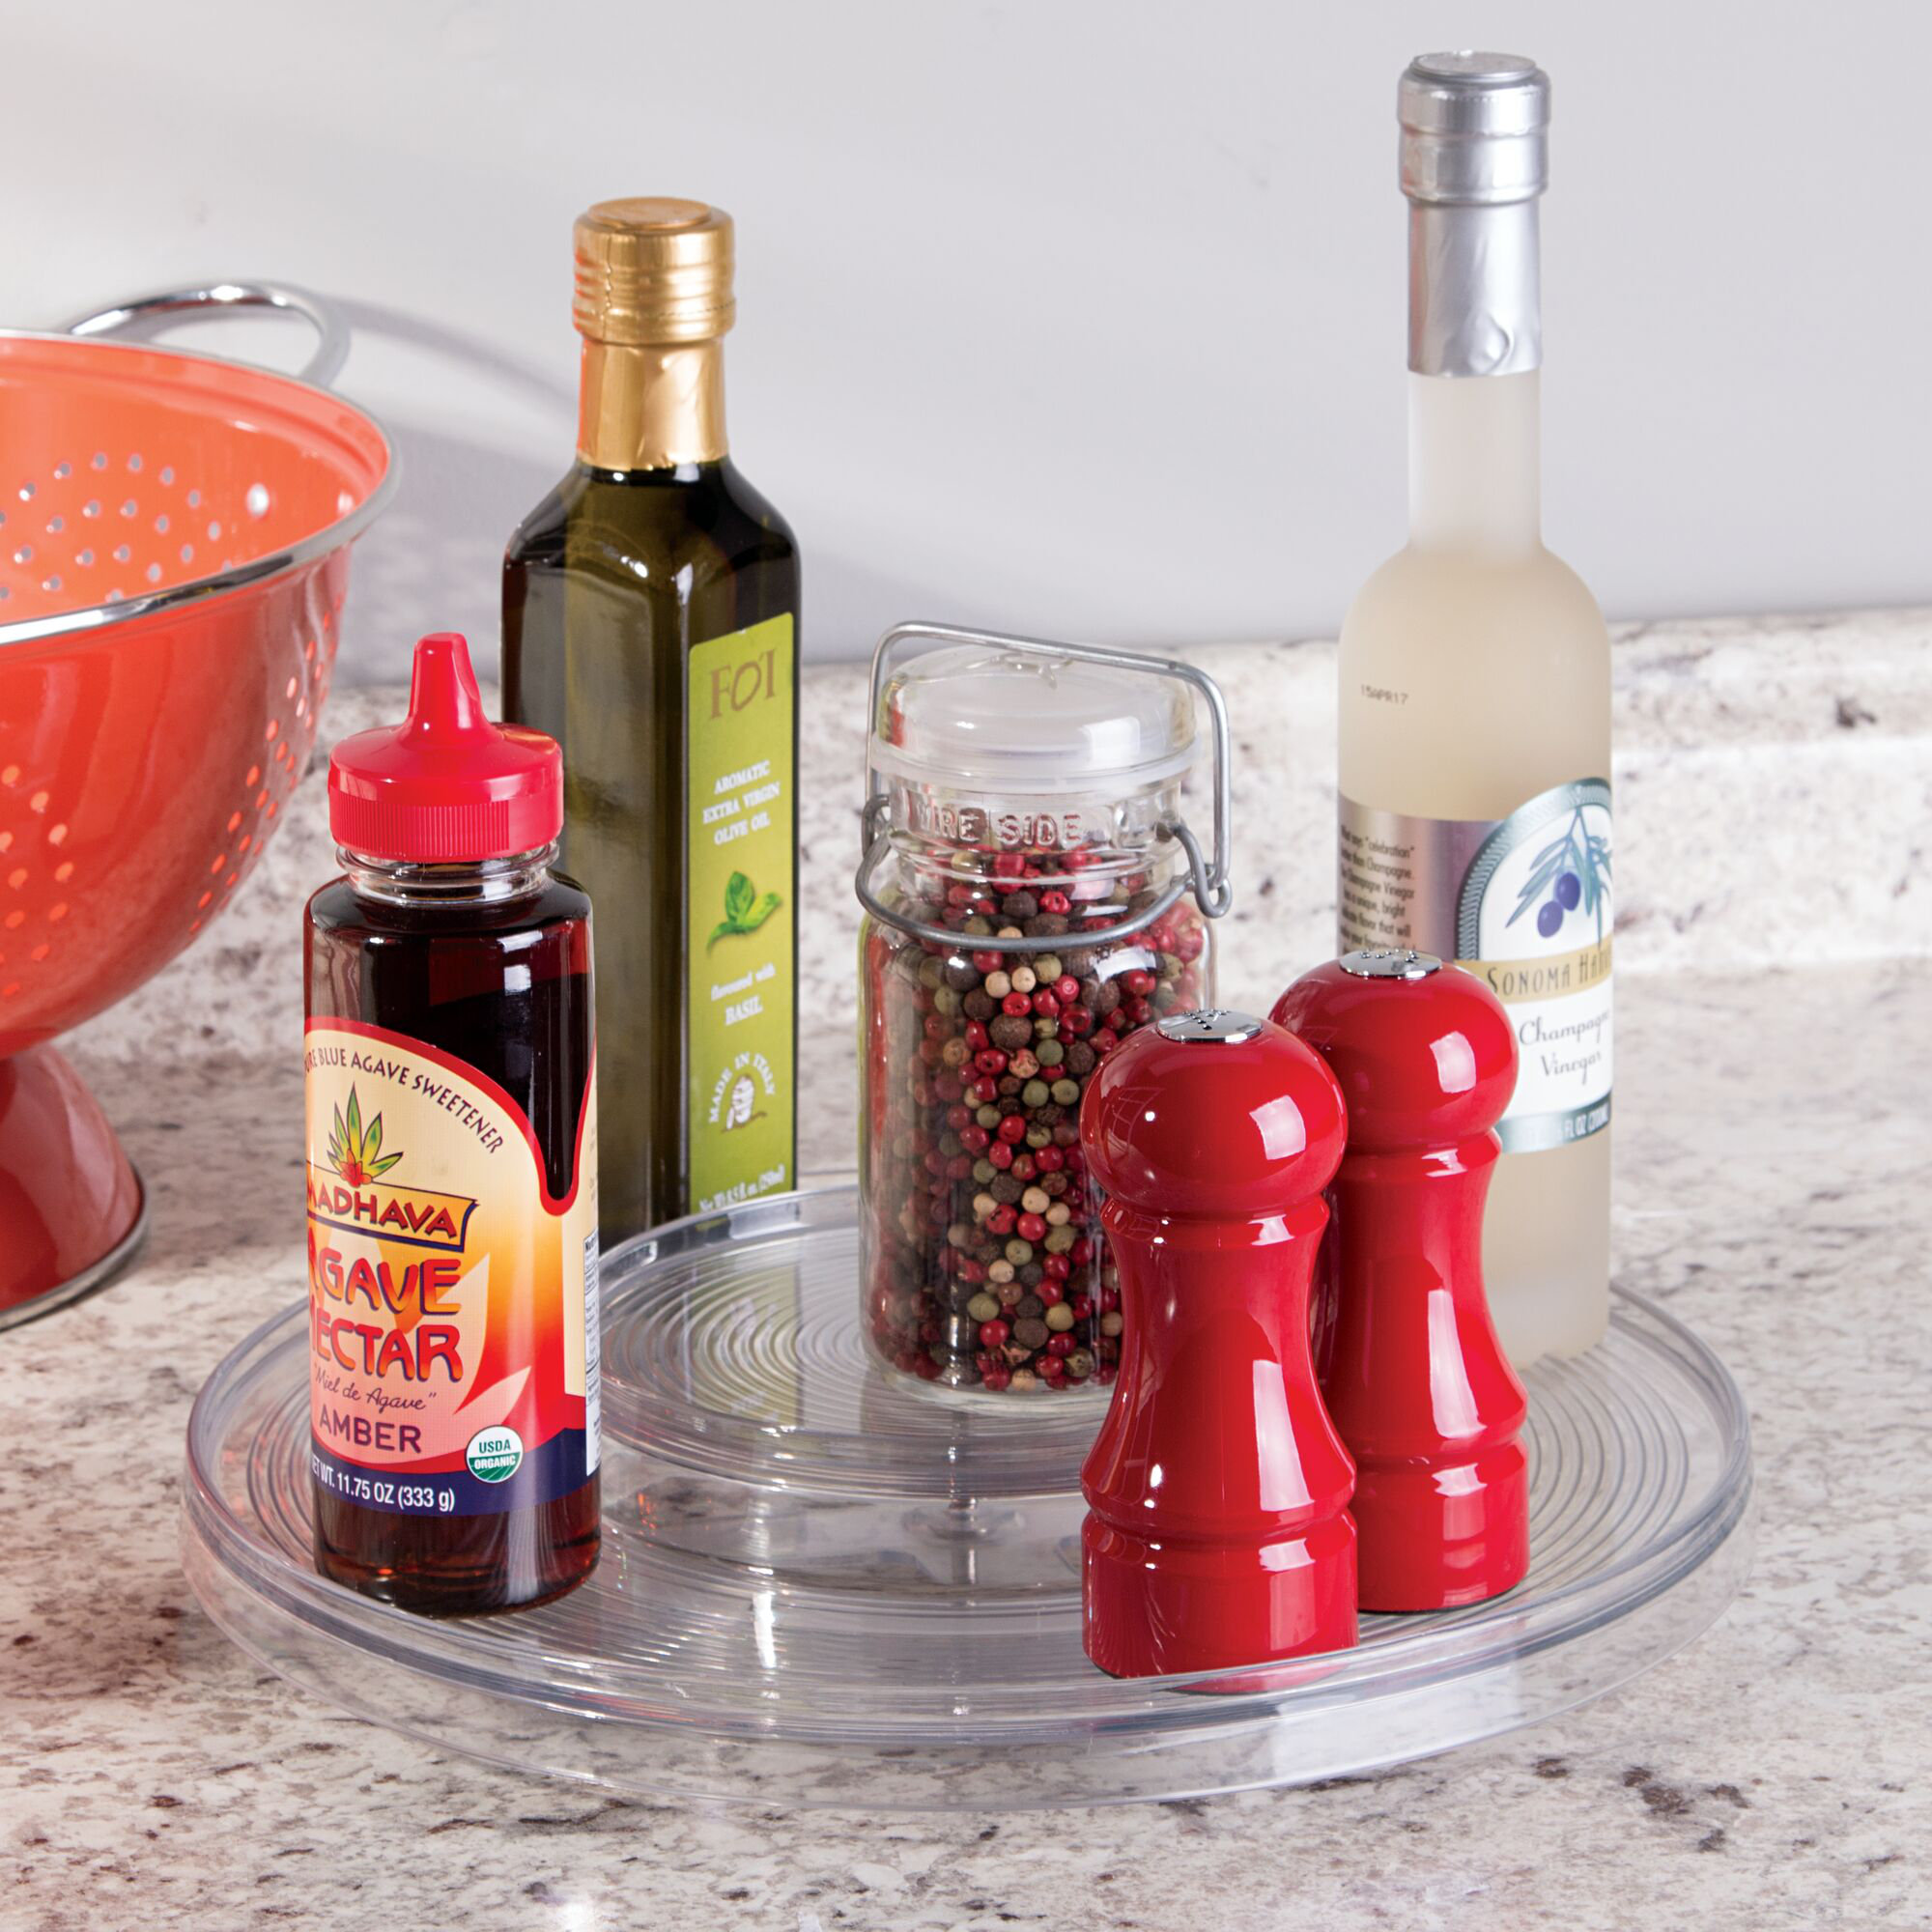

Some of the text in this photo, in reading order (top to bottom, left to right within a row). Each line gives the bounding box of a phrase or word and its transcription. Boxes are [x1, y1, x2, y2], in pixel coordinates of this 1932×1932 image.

[714, 759, 771, 796] AROMATIC
[703, 781, 781, 825] EXTRA VIRGIN
[714, 810, 771, 846] OLIVE OIL
[996, 813, 1081, 846] SIDE
[1487, 966, 1570, 996] SONOMA
[724, 995, 763, 1027] BASIL
[1541, 1051, 1603, 1086] Vinegar
[318, 1047, 347, 1067] BLUE
[351, 1050, 411, 1086] AGAVE
[412, 1073, 503, 1154] SWEETENER
[709, 1050, 776, 1124] MADE IN ITALY
[342, 1382, 361, 1401] de
[320, 1404, 422, 1454] AMBER
[479, 1439, 511, 1454] USDA
[474, 1455, 516, 1470] ORGANIC
[311, 1453, 455, 1512] ET WT. 11.75 OZ (333 g)
